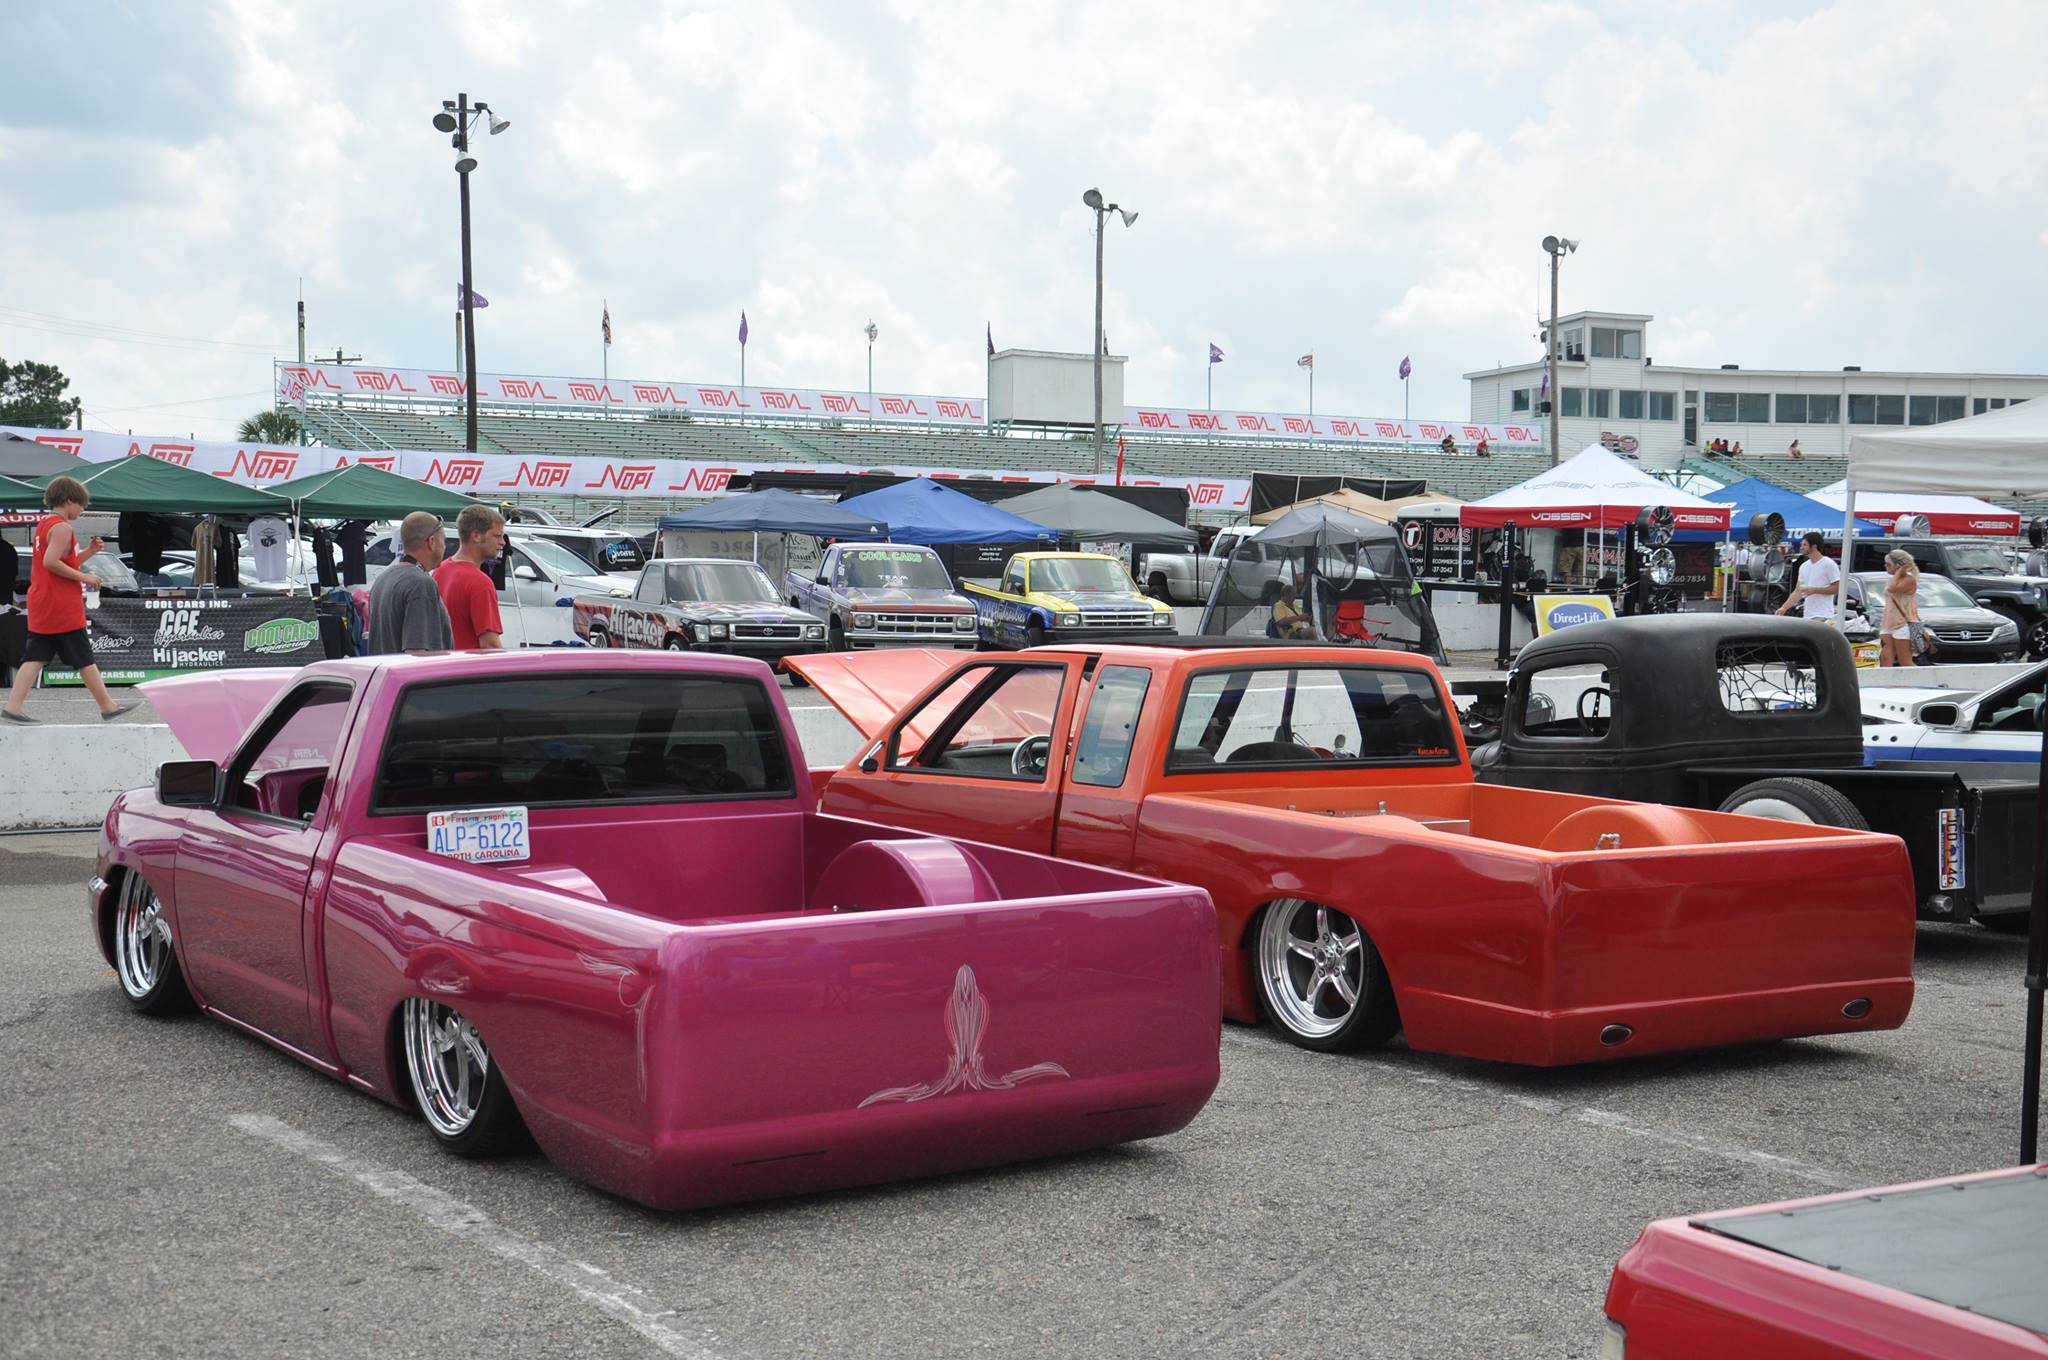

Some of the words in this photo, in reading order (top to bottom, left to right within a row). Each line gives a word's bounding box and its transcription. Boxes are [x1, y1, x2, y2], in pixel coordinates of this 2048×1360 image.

[211, 449, 299, 480] NOPI
[419, 458, 485, 486] NOPI
[498, 461, 572, 487] NOPI
[585, 463, 656, 490] NOPI
[1531, 512, 1592, 521] VOSSEN
[1968, 520, 2014, 529] VOSSEN
[145, 600, 172, 609] COOL
[177, 600, 205, 609] CARS
[209, 600, 232, 609] INC.
[159, 610, 201, 636] CCE
[1553, 612, 1600, 624] Direct-Lift
[247, 626, 282, 649] COOL
[283, 621, 317, 643] CARS
[255, 640, 311, 654] engineering
[153, 648, 226, 668] Hijacker
[179, 660, 224, 668] HYDRAULICS
[434, 821, 524, 853] ALP-6122
[475, 848, 520, 860] CAROLINA
